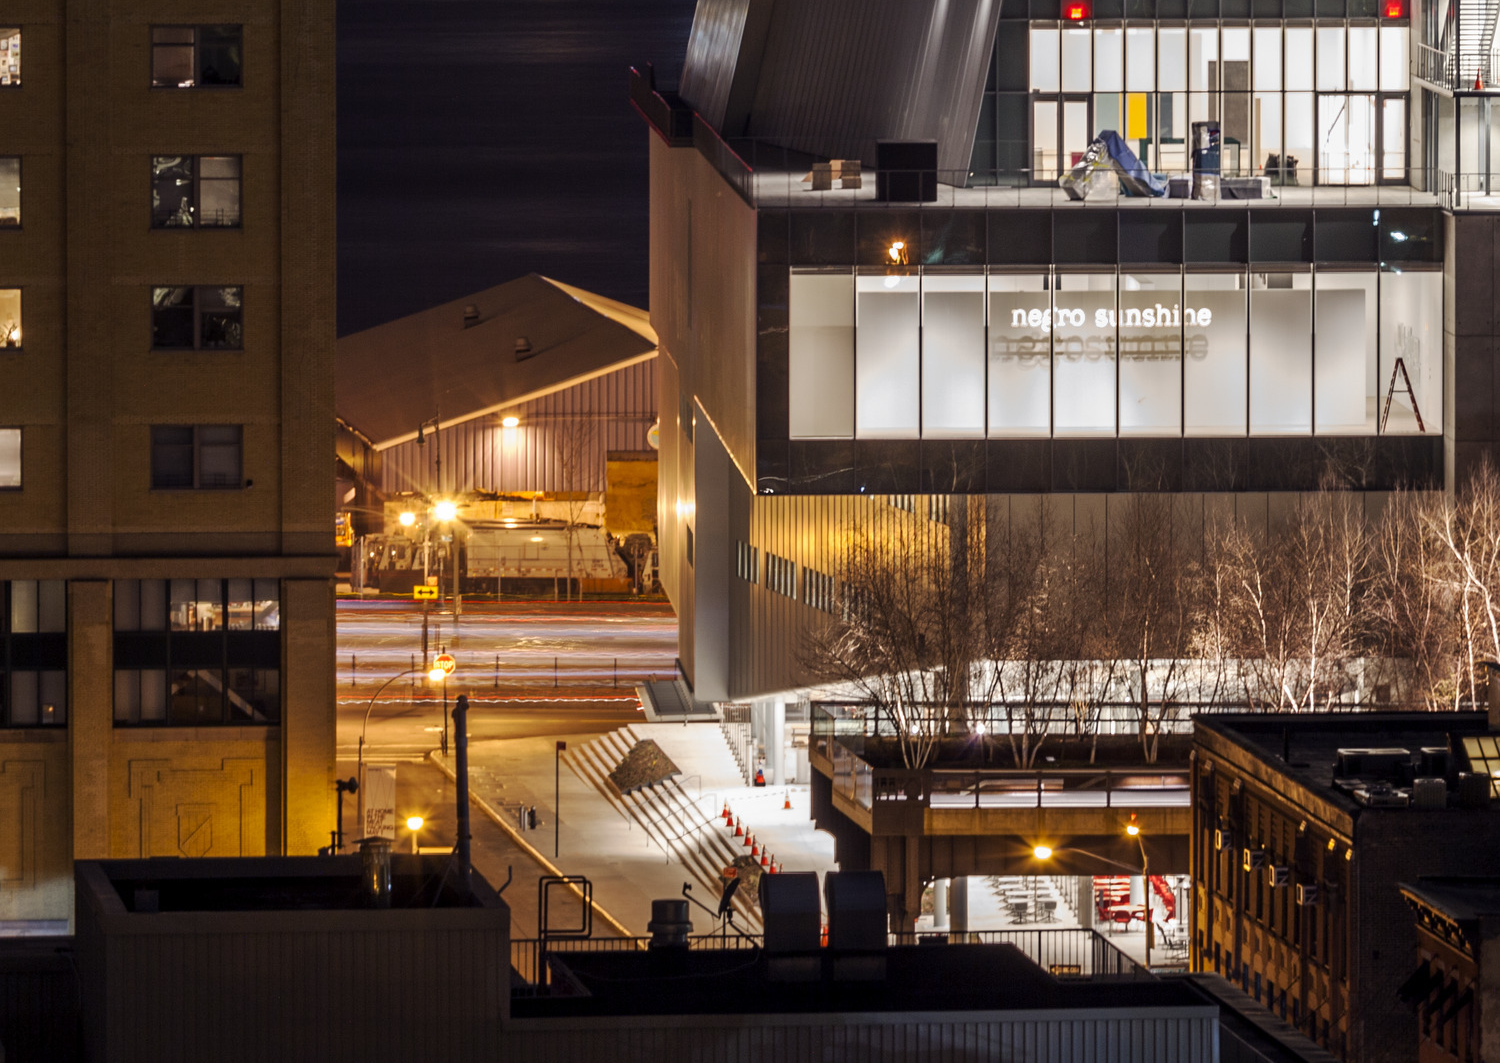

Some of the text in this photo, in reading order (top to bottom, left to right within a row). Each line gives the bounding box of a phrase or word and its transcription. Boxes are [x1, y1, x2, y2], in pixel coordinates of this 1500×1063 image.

[1011, 303, 1212, 332] negro sunshine
[435, 660, 454, 669] STOP
